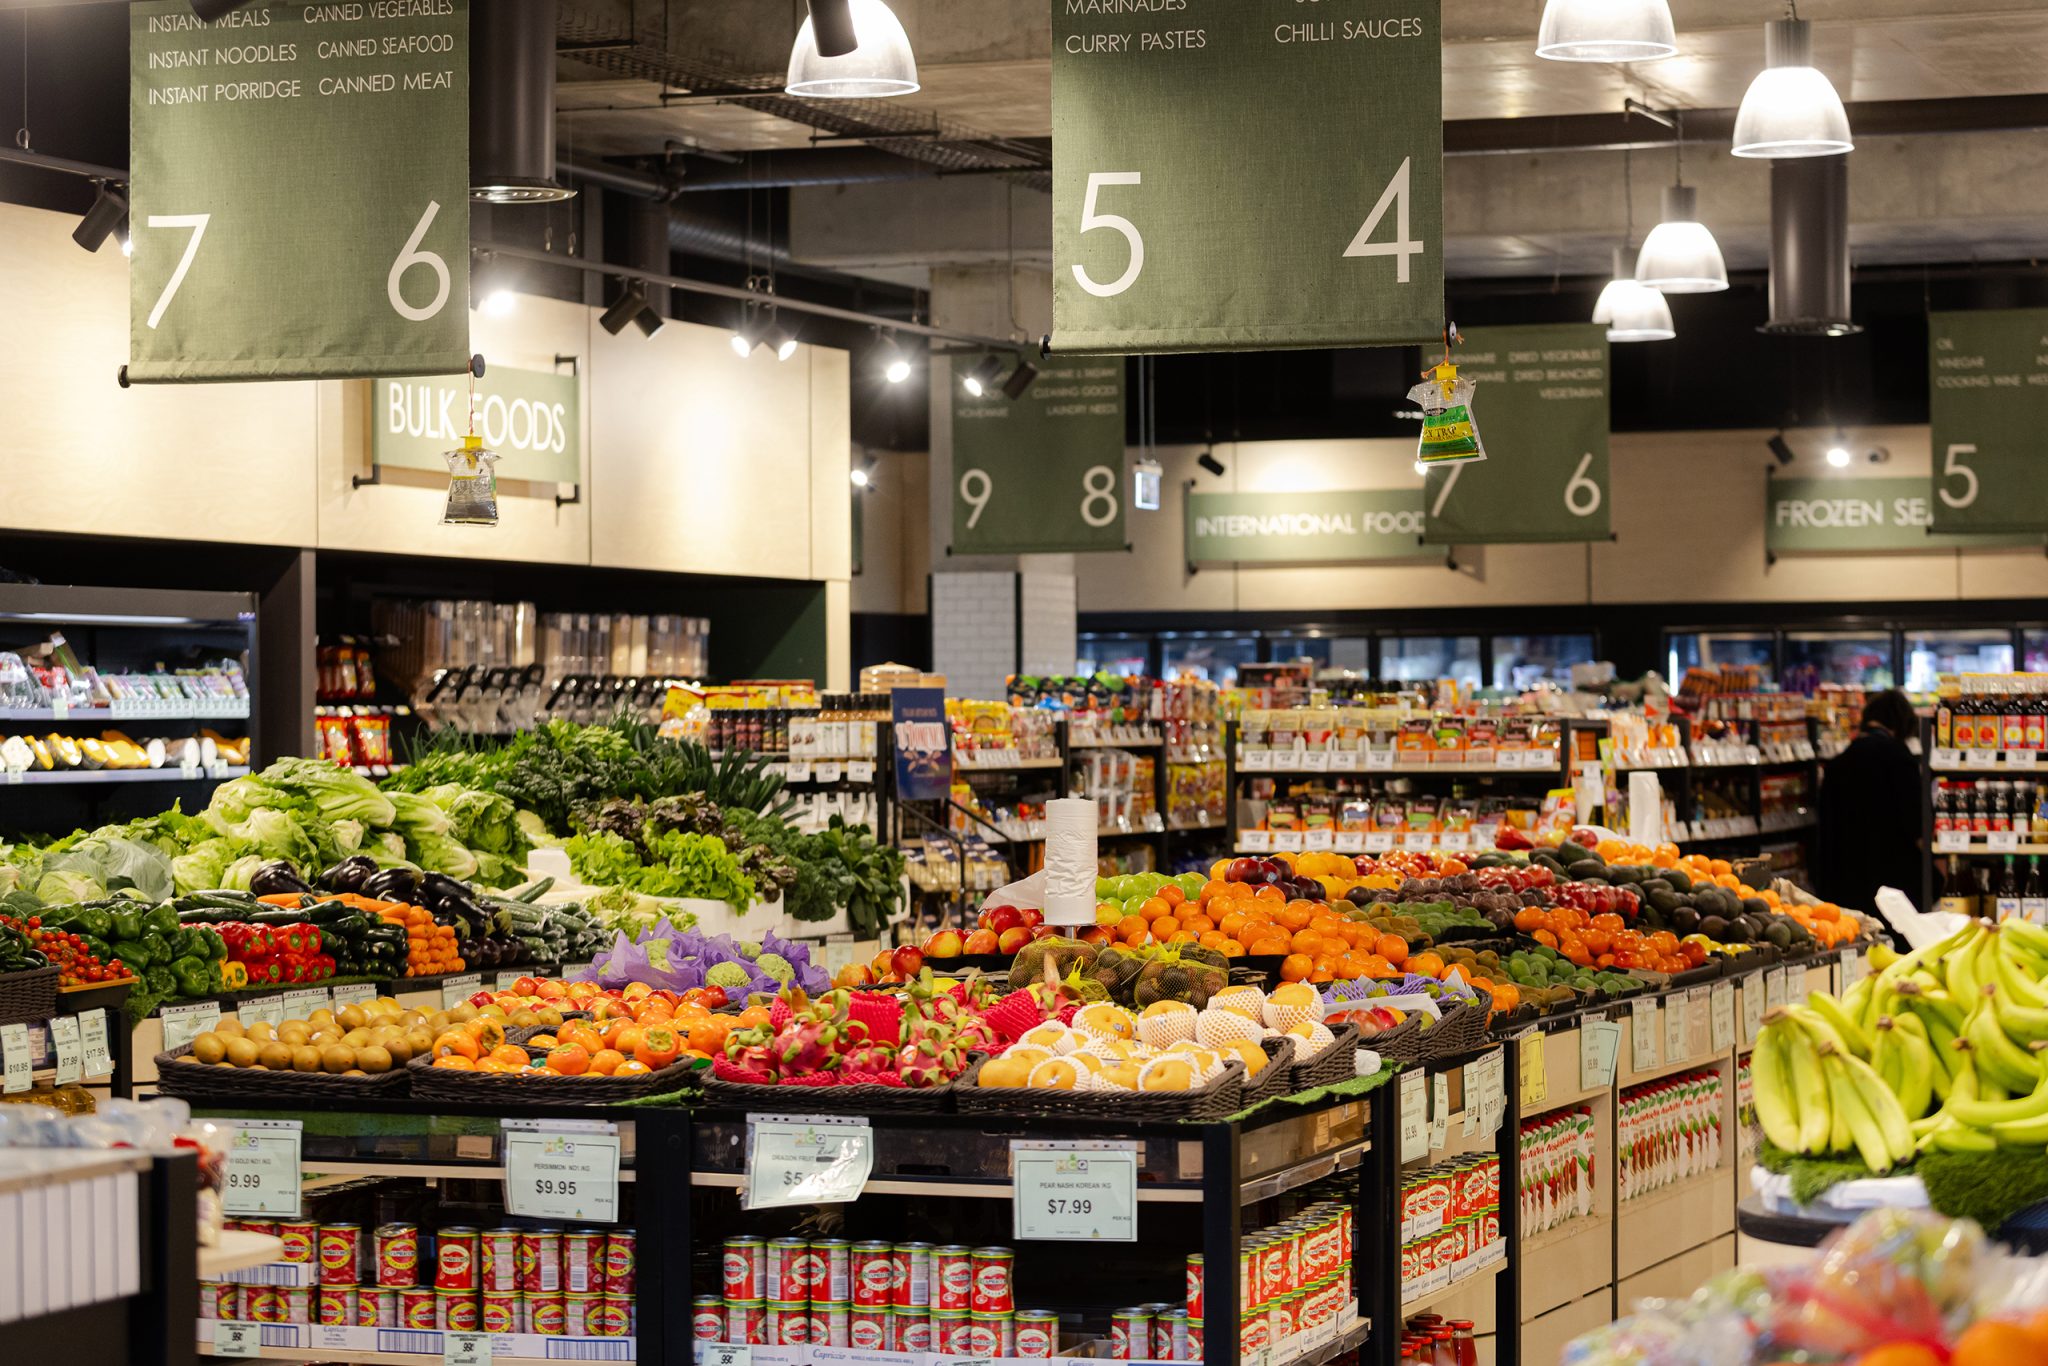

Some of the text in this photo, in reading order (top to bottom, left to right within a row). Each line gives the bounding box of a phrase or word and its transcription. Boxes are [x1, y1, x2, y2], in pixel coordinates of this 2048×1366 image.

[215, 8, 270, 29] MEALS
[303, 0, 454, 24] CANNED VEGETABLES
[1065, 29, 1206, 54] CURRY PASTES
[1274, 17, 1422, 43] CHILLI SAUCES
[149, 43, 297, 69] INSTANT NOODLES
[317, 34, 454, 59] CANNED SEAFOOD
[149, 80, 301, 105] INSTANT PORRIDGE
[318, 71, 454, 96] CANNED MEAT
[1342, 156, 1424, 283] 4
[1071, 171, 1145, 298] 5
[146, 213, 211, 330] 7
[387, 200, 451, 321] 6
[389, 381, 566, 454] BULK FOODS
[1564, 452, 1601, 517] 6
[1938, 443, 1979, 508] 5
[960, 468, 993, 529] 9
[1080, 465, 1118, 527] 8
[1195, 510, 1425, 538] INTERNATIONAL FOOD
[1775, 498, 1935, 528] FROZEN SE
[229, 1174, 261, 1189] 9.99
[535, 1179, 577, 1195] $9.95
[1047, 1198, 1092, 1215] $7.99
